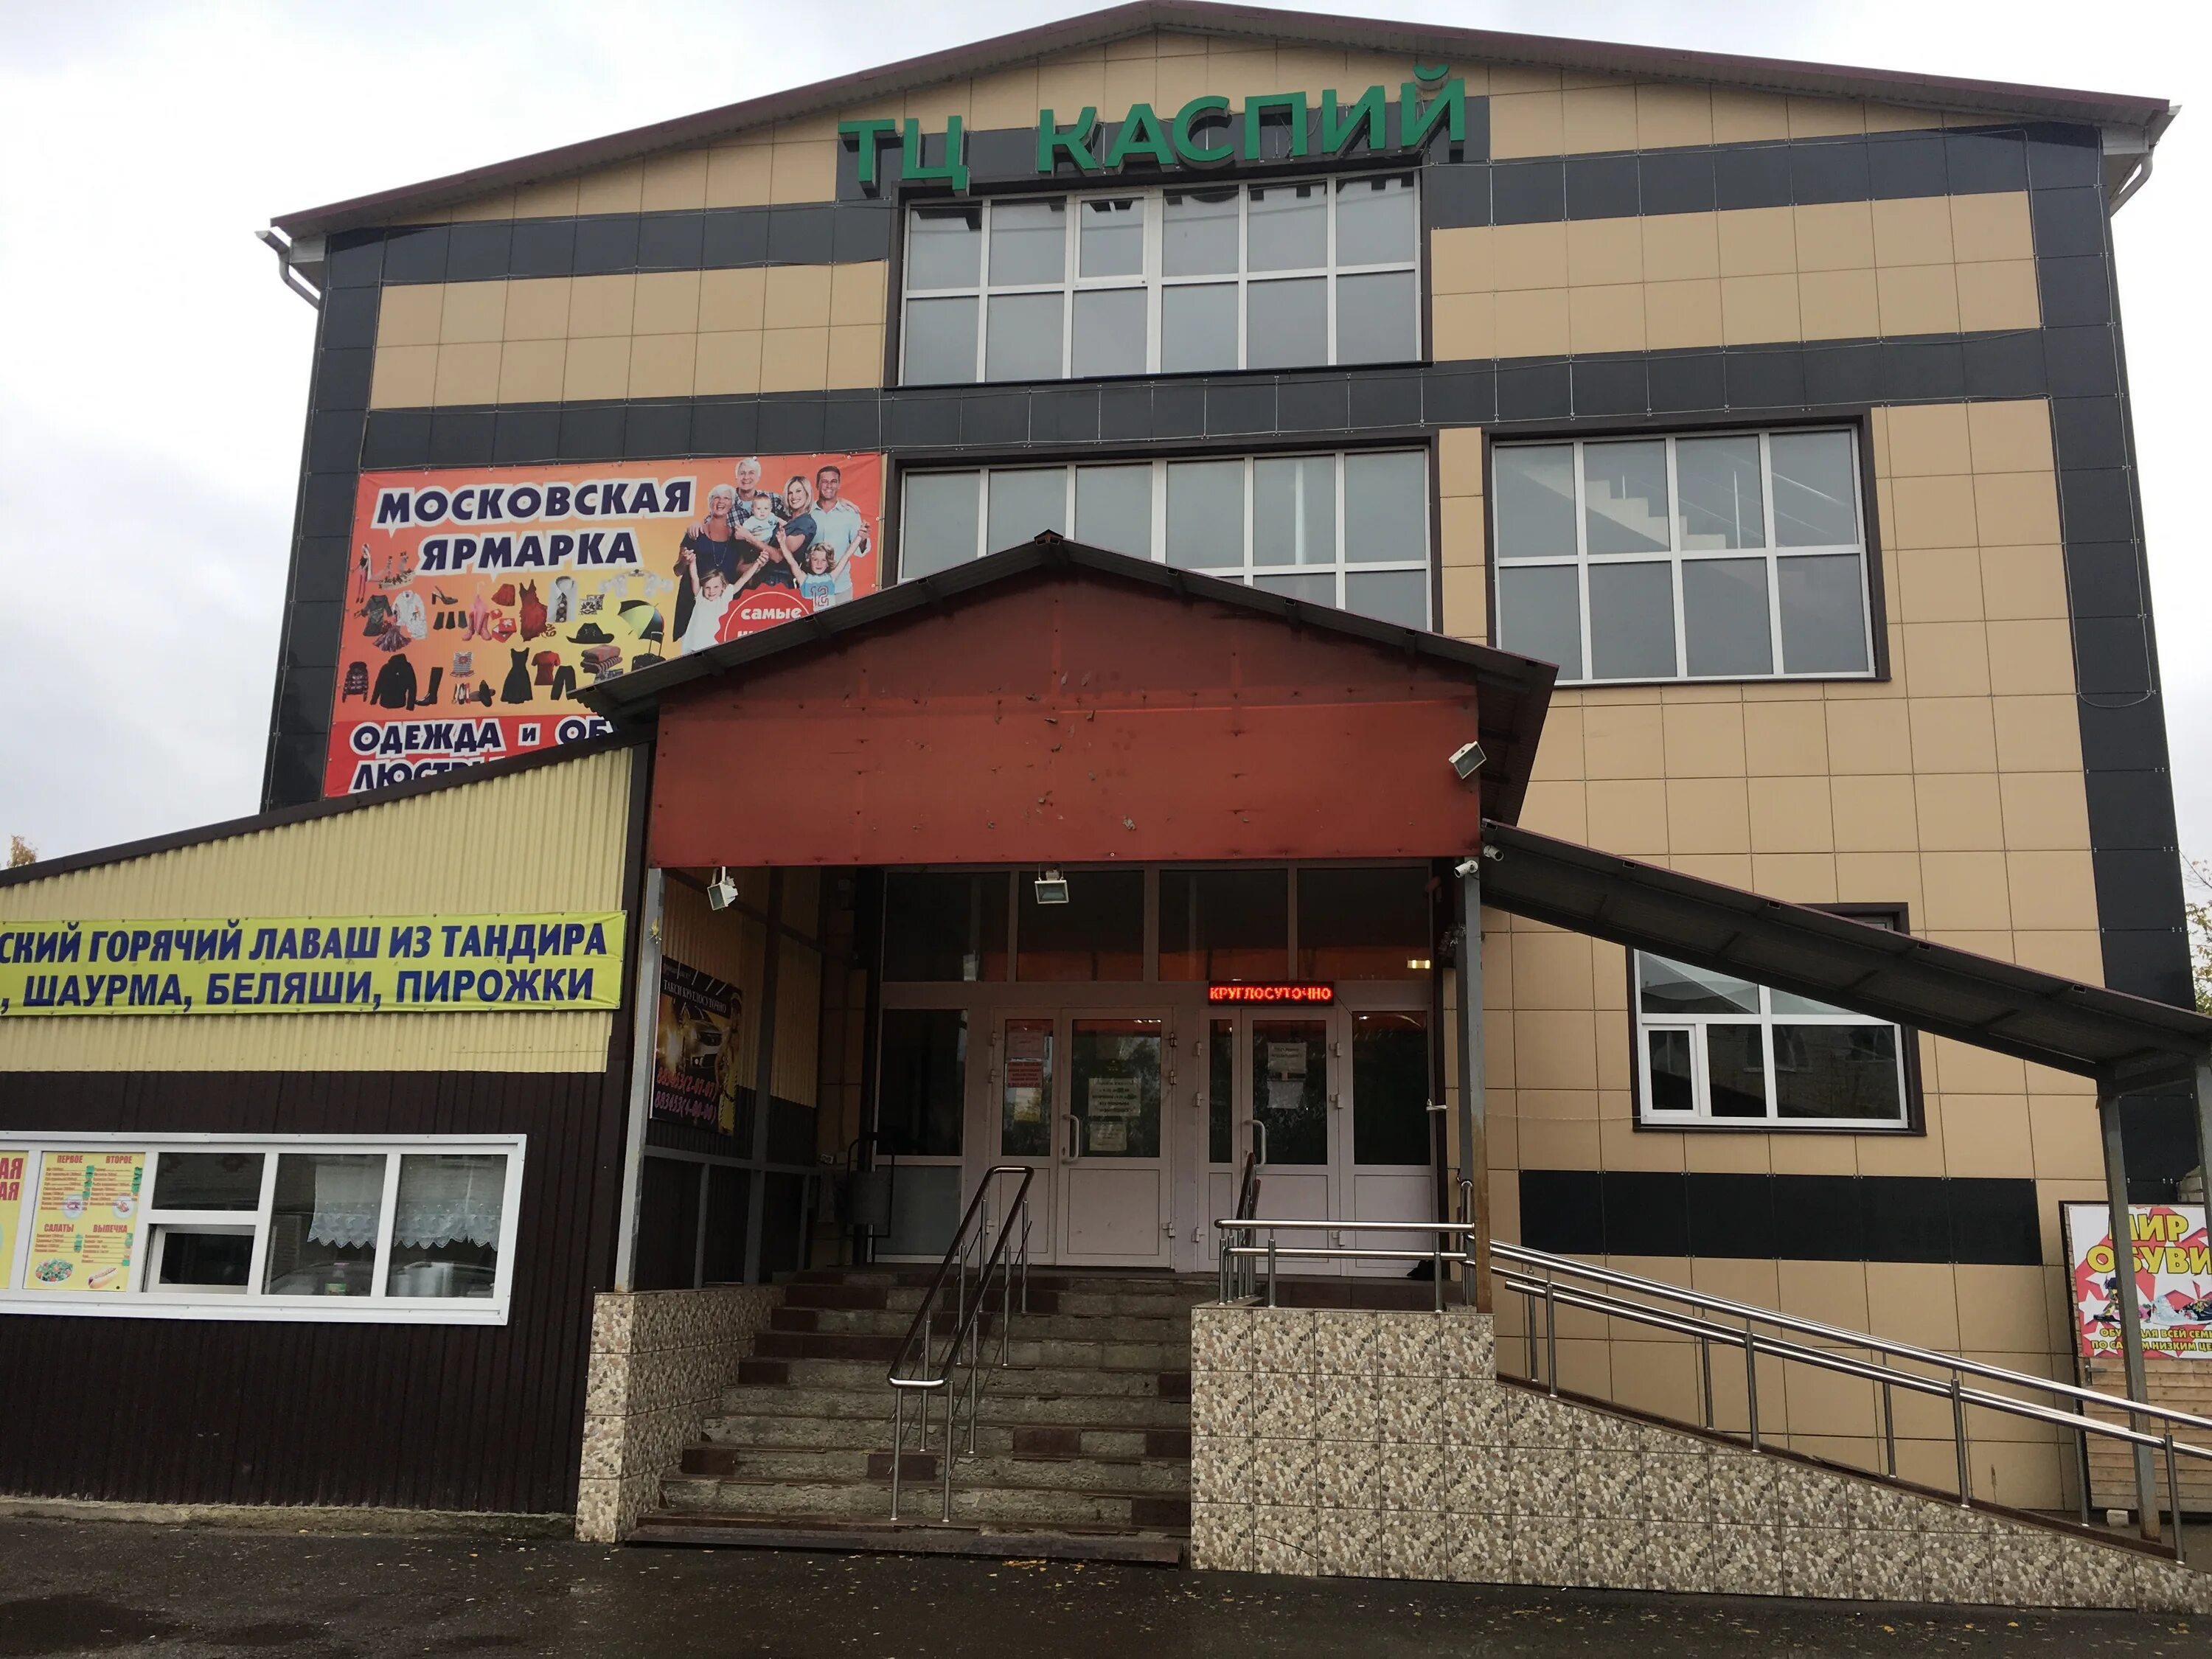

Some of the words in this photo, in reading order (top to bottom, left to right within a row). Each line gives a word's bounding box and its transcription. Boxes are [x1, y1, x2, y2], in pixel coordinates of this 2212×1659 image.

[838, 114, 970, 195] ТЦ
[1038, 64, 1466, 173] КАСПИЙ
[375, 480, 692, 524] МОСКОВСКАЯ
[420, 532, 638, 571] ЯРМАРКА
[811, 585, 830, 607] 12
[740, 607, 803, 620] самые
[352, 721, 503, 754] ОДЕЖДА
[521, 726, 538, 742] и
[558, 719, 613, 744] ОБ
[0, 922, 82, 964] СКИЙ
[88, 918, 243, 963] ГОРЯЧИЙ
[248, 926, 381, 961] ЛАВАШ
[388, 925, 432, 959] ИЗ
[441, 922, 608, 964] ТАНДИРА
[23, 973, 192, 1013] ШАУРМА,
[206, 970, 382, 1011] БЕЛЯШИ,
[396, 967, 594, 1004] ПИРОЖКИ
[1209, 987, 1333, 1001] КРУГЛОСУТОЧНО
[57, 1155, 83, 1164] ПЕРВОЕ
[105, 1155, 133, 1164] ВТОРОЕ
[44, 1223, 74, 1232] САЛАТЫ
[93, 1224, 128, 1233] ВЫПЕЧКА
[2160, 1328, 2188, 1338] ВСЕЙ
[2091, 1340, 2108, 1349] ПО
[2152, 1341, 2197, 1351] НИЗКИМ
